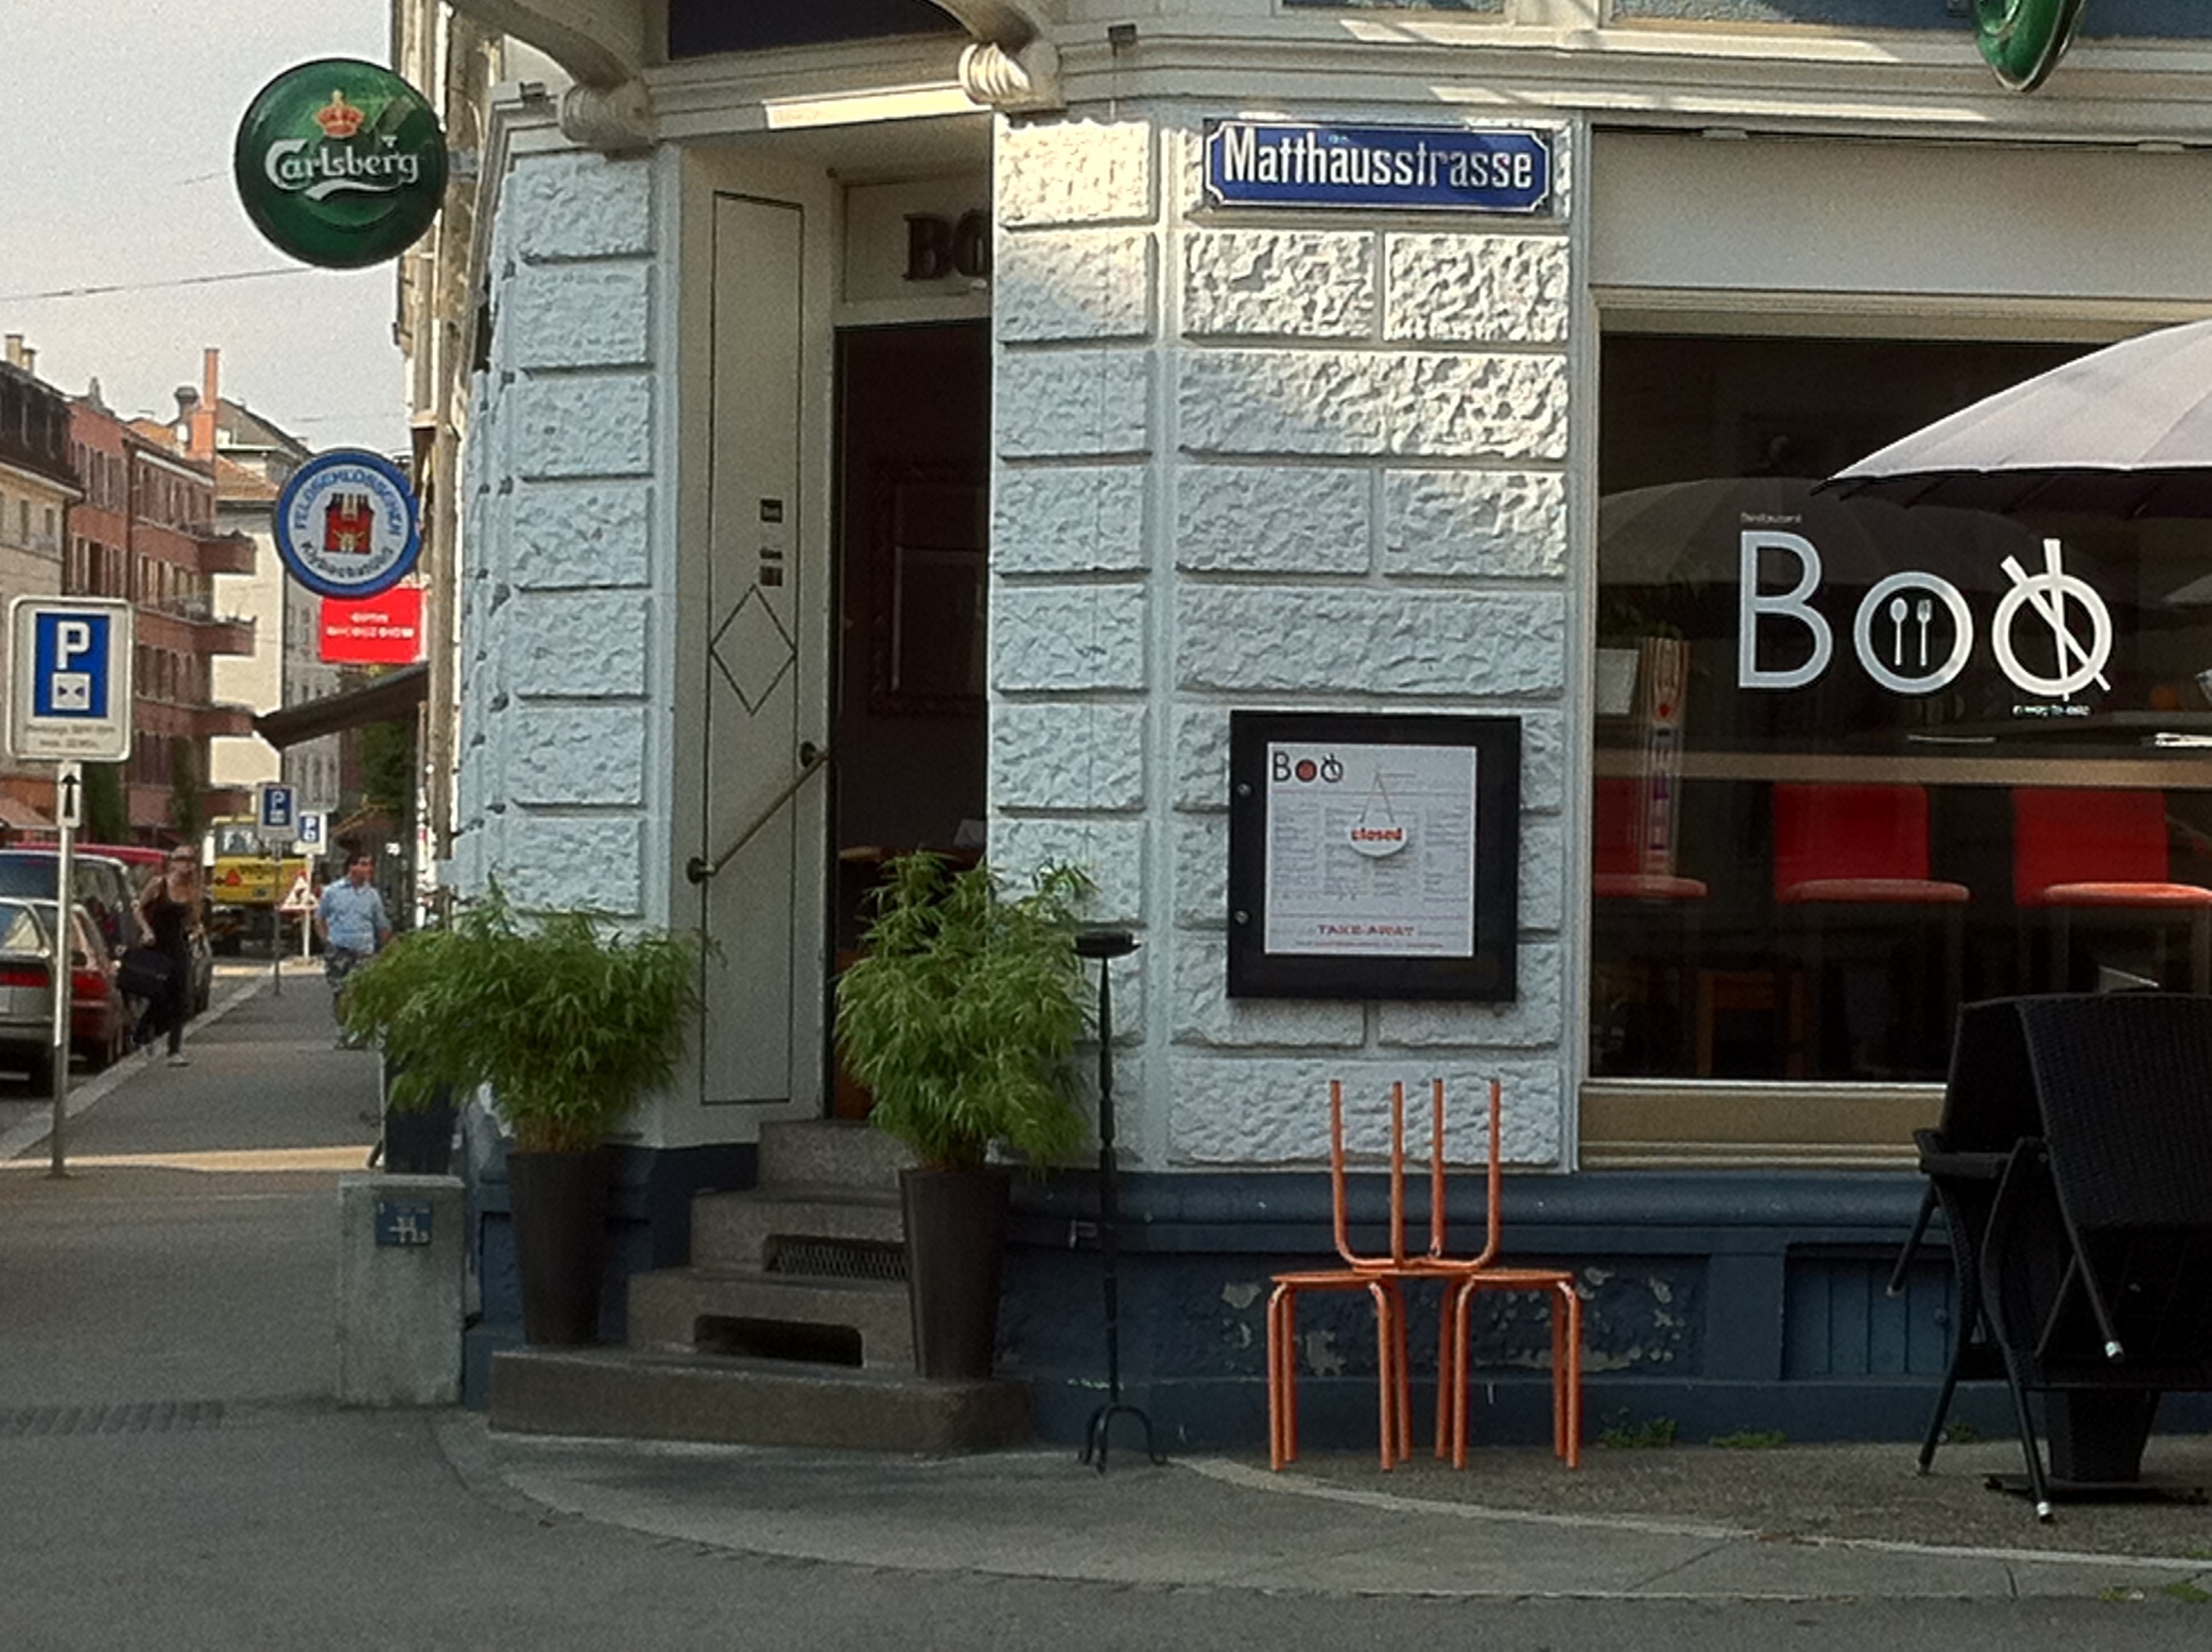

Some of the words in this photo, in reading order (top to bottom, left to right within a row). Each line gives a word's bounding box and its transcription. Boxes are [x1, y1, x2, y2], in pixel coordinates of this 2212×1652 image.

[265, 136, 419, 191] Carlsberg
[1223, 127, 1533, 189] Matthäusstrasse
[56, 621, 90, 670] P
[271, 791, 286, 809] P
[1351, 827, 1402, 841] closed
